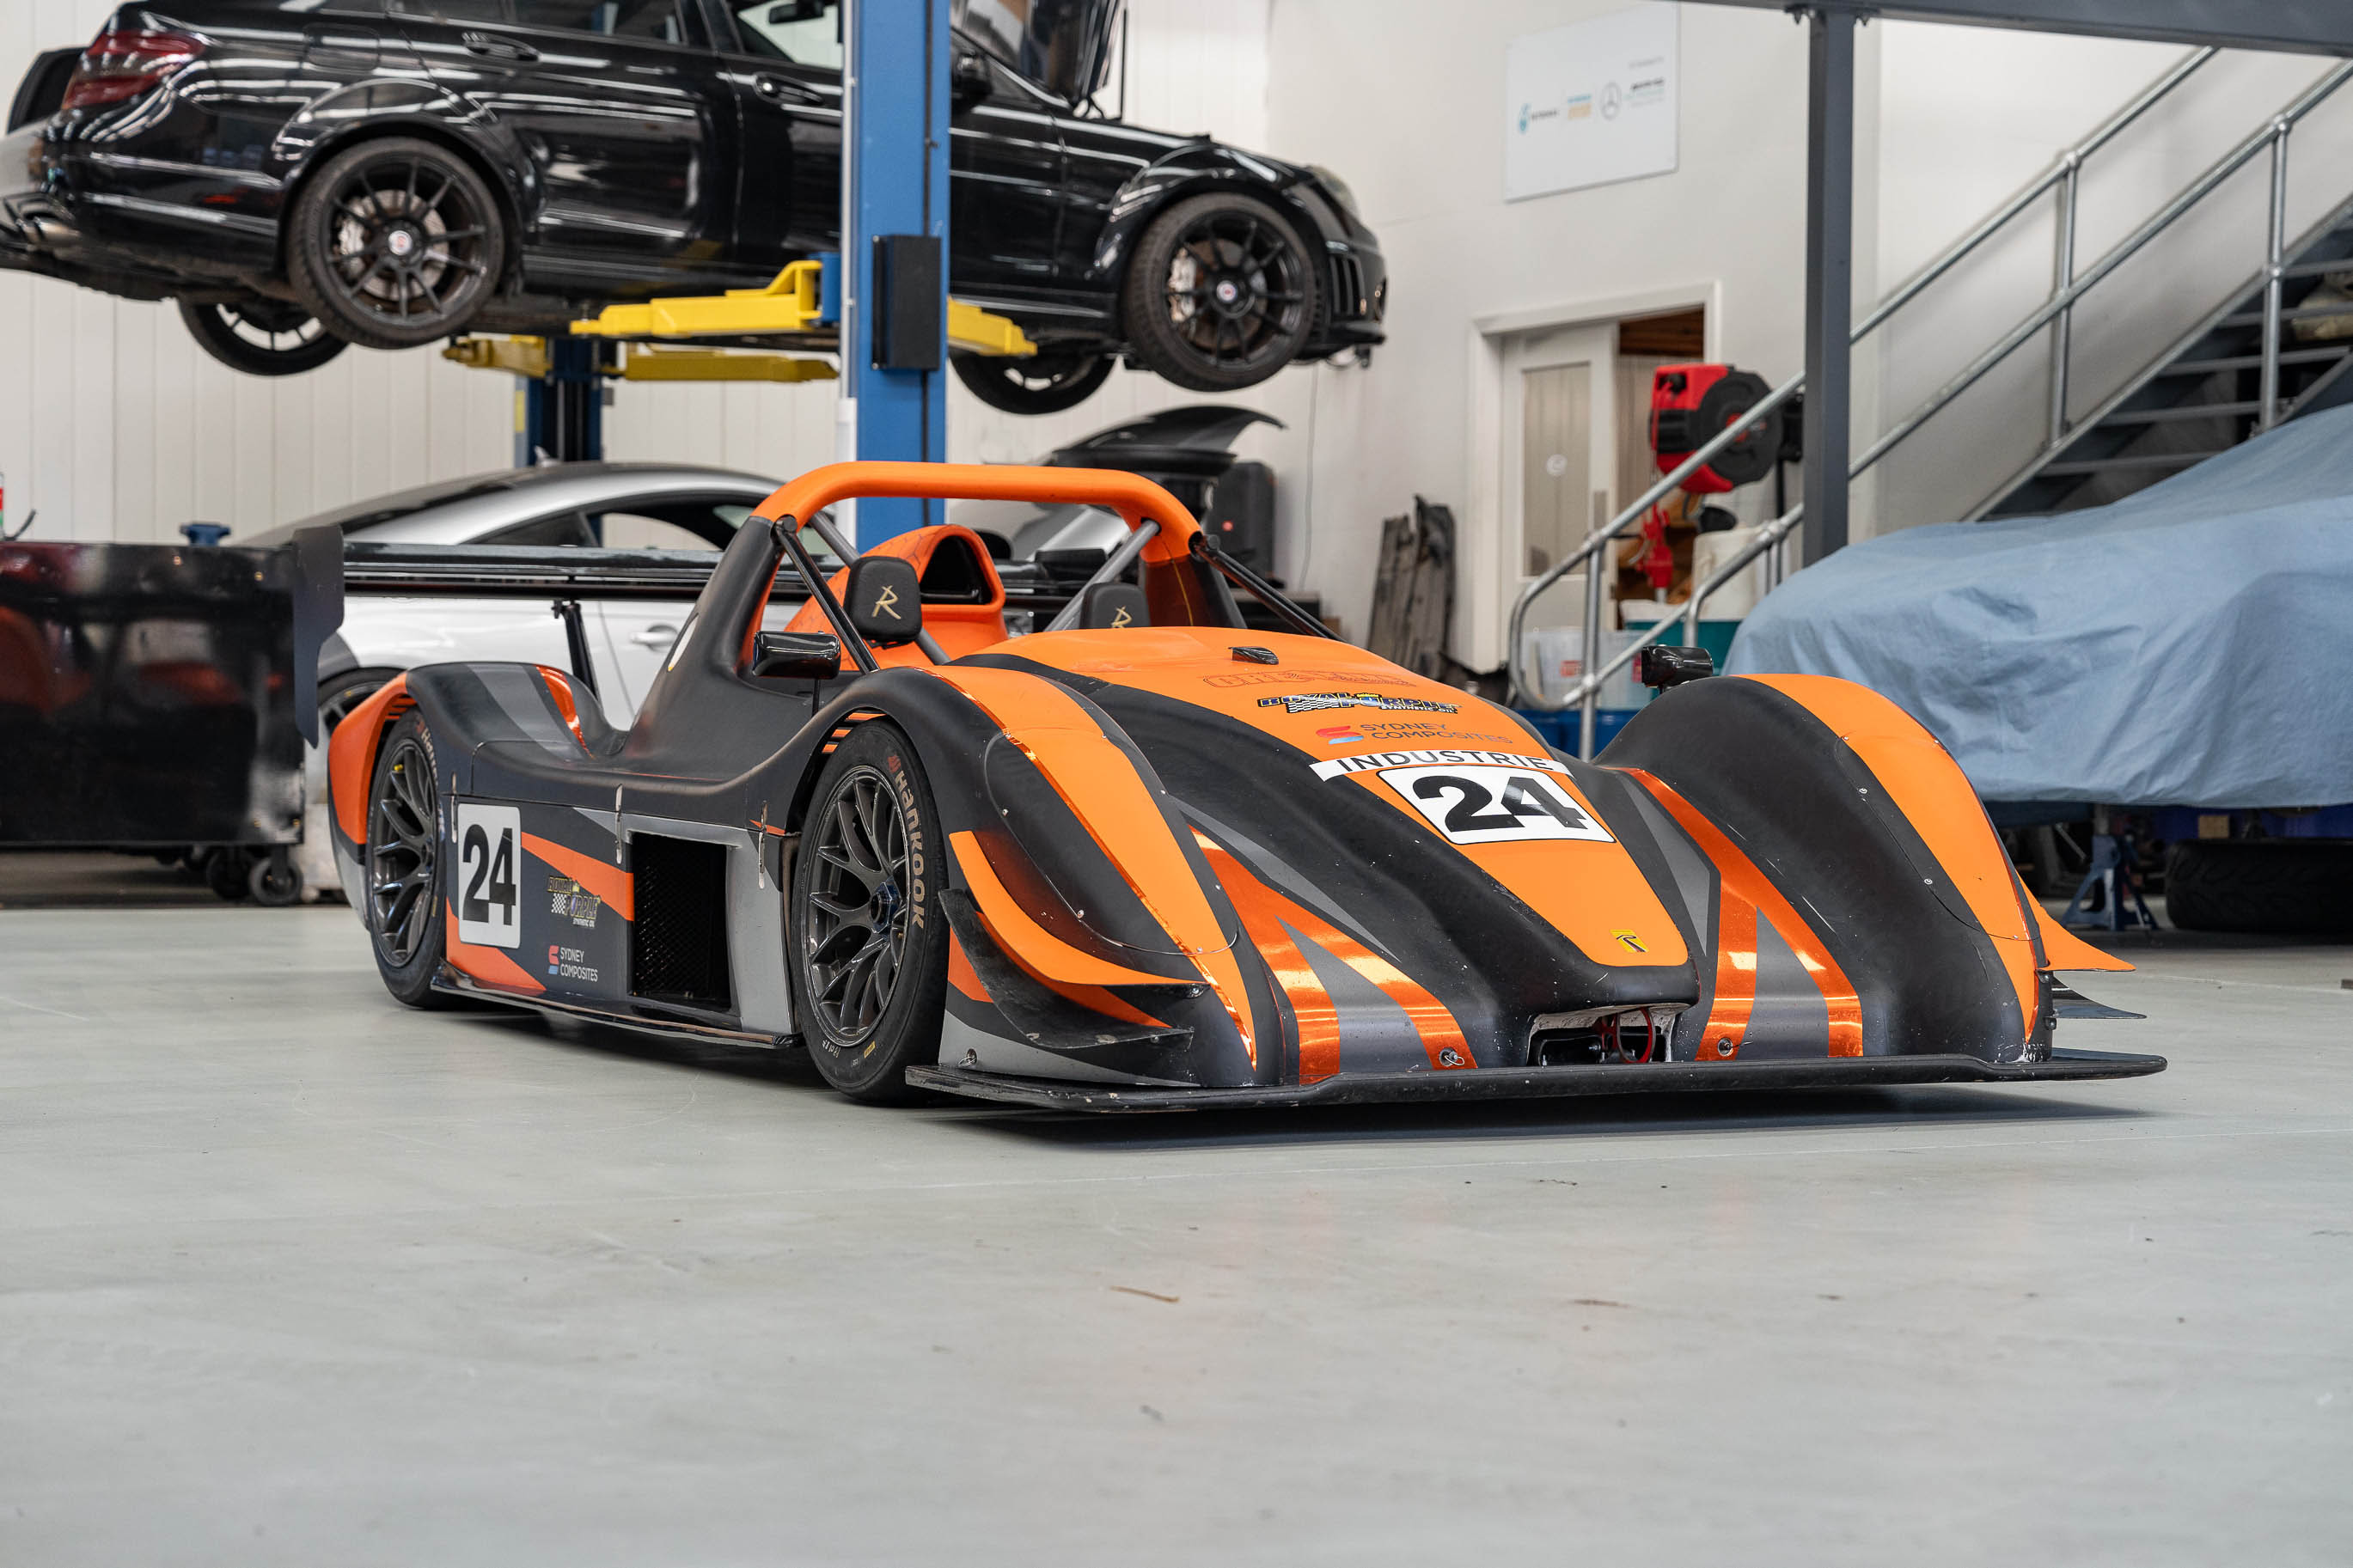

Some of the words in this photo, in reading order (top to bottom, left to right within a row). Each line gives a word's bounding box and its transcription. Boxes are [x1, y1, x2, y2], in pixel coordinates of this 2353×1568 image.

[1258, 692, 1352, 707] ROYAL
[1341, 695, 1458, 710] PURPLE
[1360, 723, 1446, 731] SYDNEY
[1372, 731, 1513, 744] COMPOSITES
[1336, 750, 1555, 772] INDUSTRIE
[1412, 776, 1589, 833] 24
[462, 824, 516, 926] 24
[564, 894, 599, 920] PURPLE
[560, 948, 584, 963] SYDNEY
[560, 964, 598, 983] COMPOSITES
